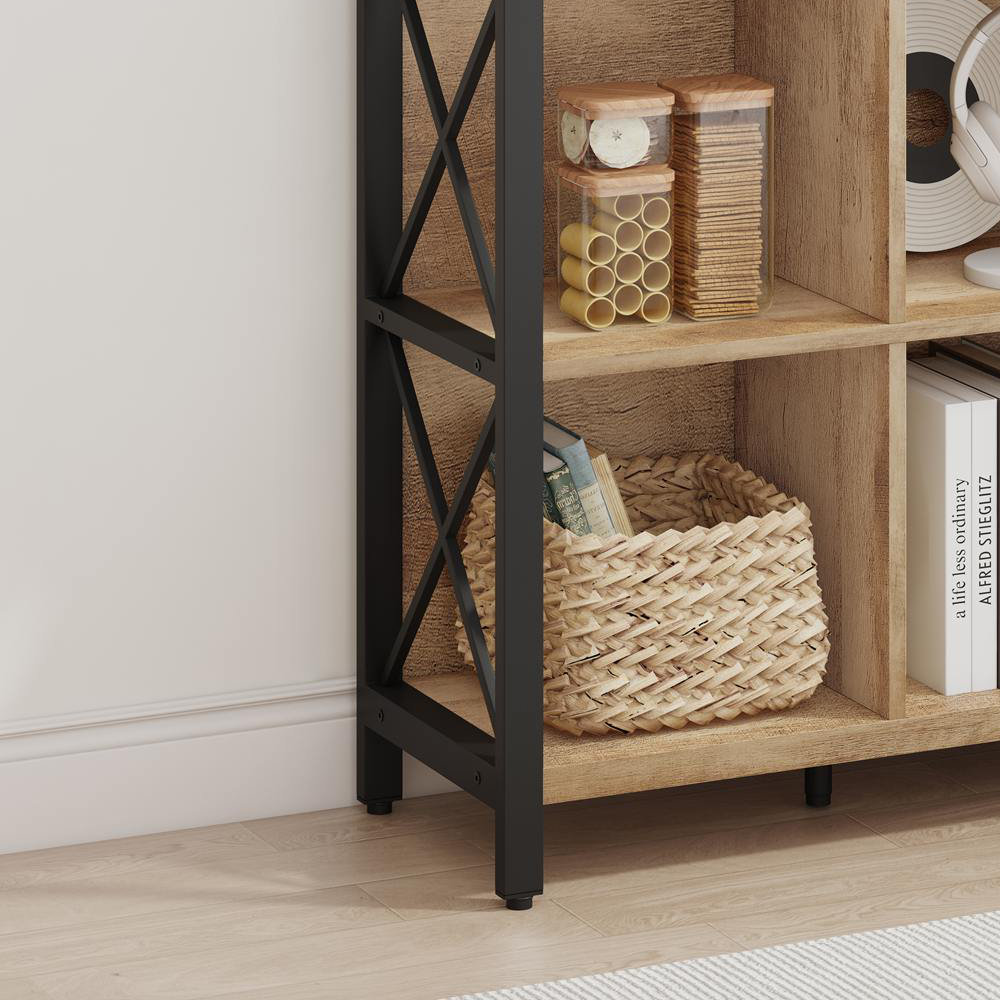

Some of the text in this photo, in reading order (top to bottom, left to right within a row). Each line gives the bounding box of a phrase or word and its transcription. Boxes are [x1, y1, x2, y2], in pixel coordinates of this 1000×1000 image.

[951, 478, 970, 619] a life less ordinary
[978, 475, 992, 605] ALFRED STIEGLITZ
